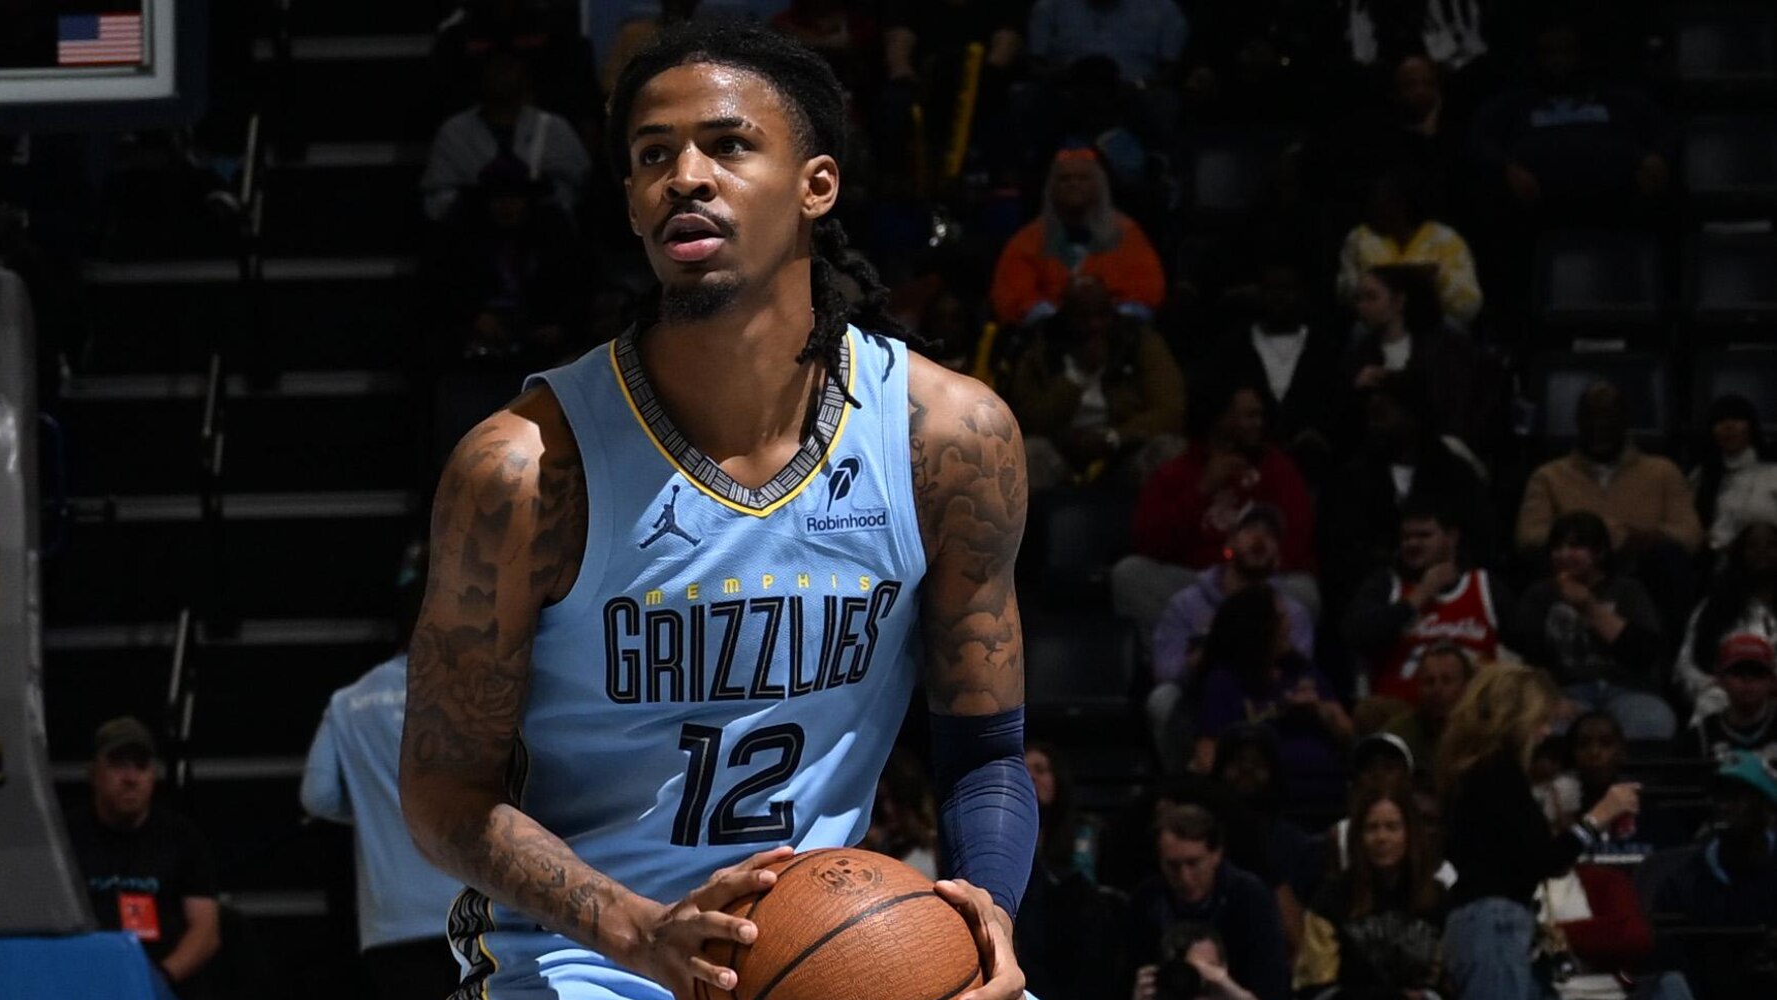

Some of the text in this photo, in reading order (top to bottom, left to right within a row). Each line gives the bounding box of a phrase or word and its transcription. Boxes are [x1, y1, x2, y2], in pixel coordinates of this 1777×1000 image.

[807, 511, 886, 532] Robinhood
[645, 573, 871, 606] MEMPHIS
[603, 580, 903, 704] GRIZZLIES
[670, 722, 805, 847] 12
